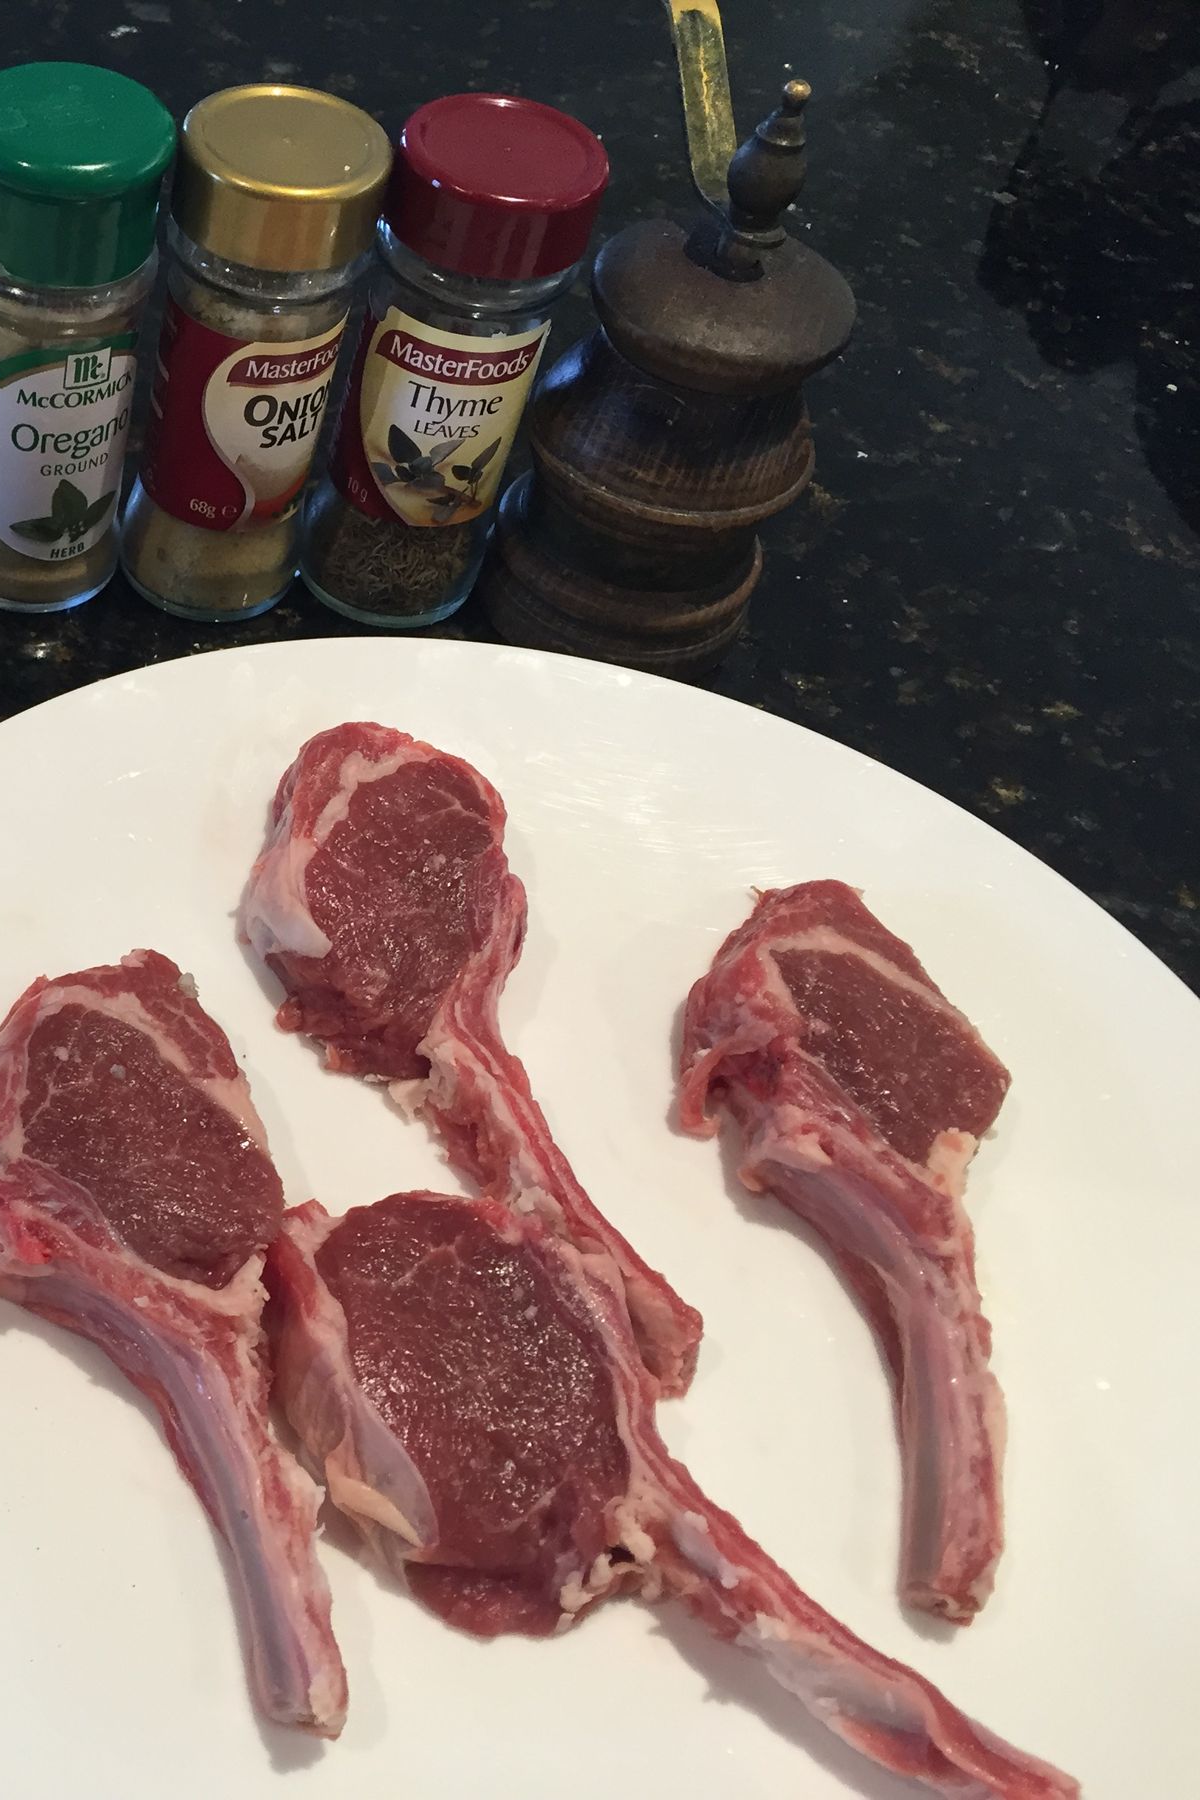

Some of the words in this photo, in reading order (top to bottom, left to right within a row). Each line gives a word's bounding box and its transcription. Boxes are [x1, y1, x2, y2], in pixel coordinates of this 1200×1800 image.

[390, 335, 529, 379] MasterFoods
[408, 381, 504, 424] Thyme
[11, 408, 129, 458] Oregano
[259, 406, 323, 448] SALT
[414, 420, 481, 438] LEAVES
[40, 452, 109, 477] GROUND
[190, 498, 216, 518] 68g
